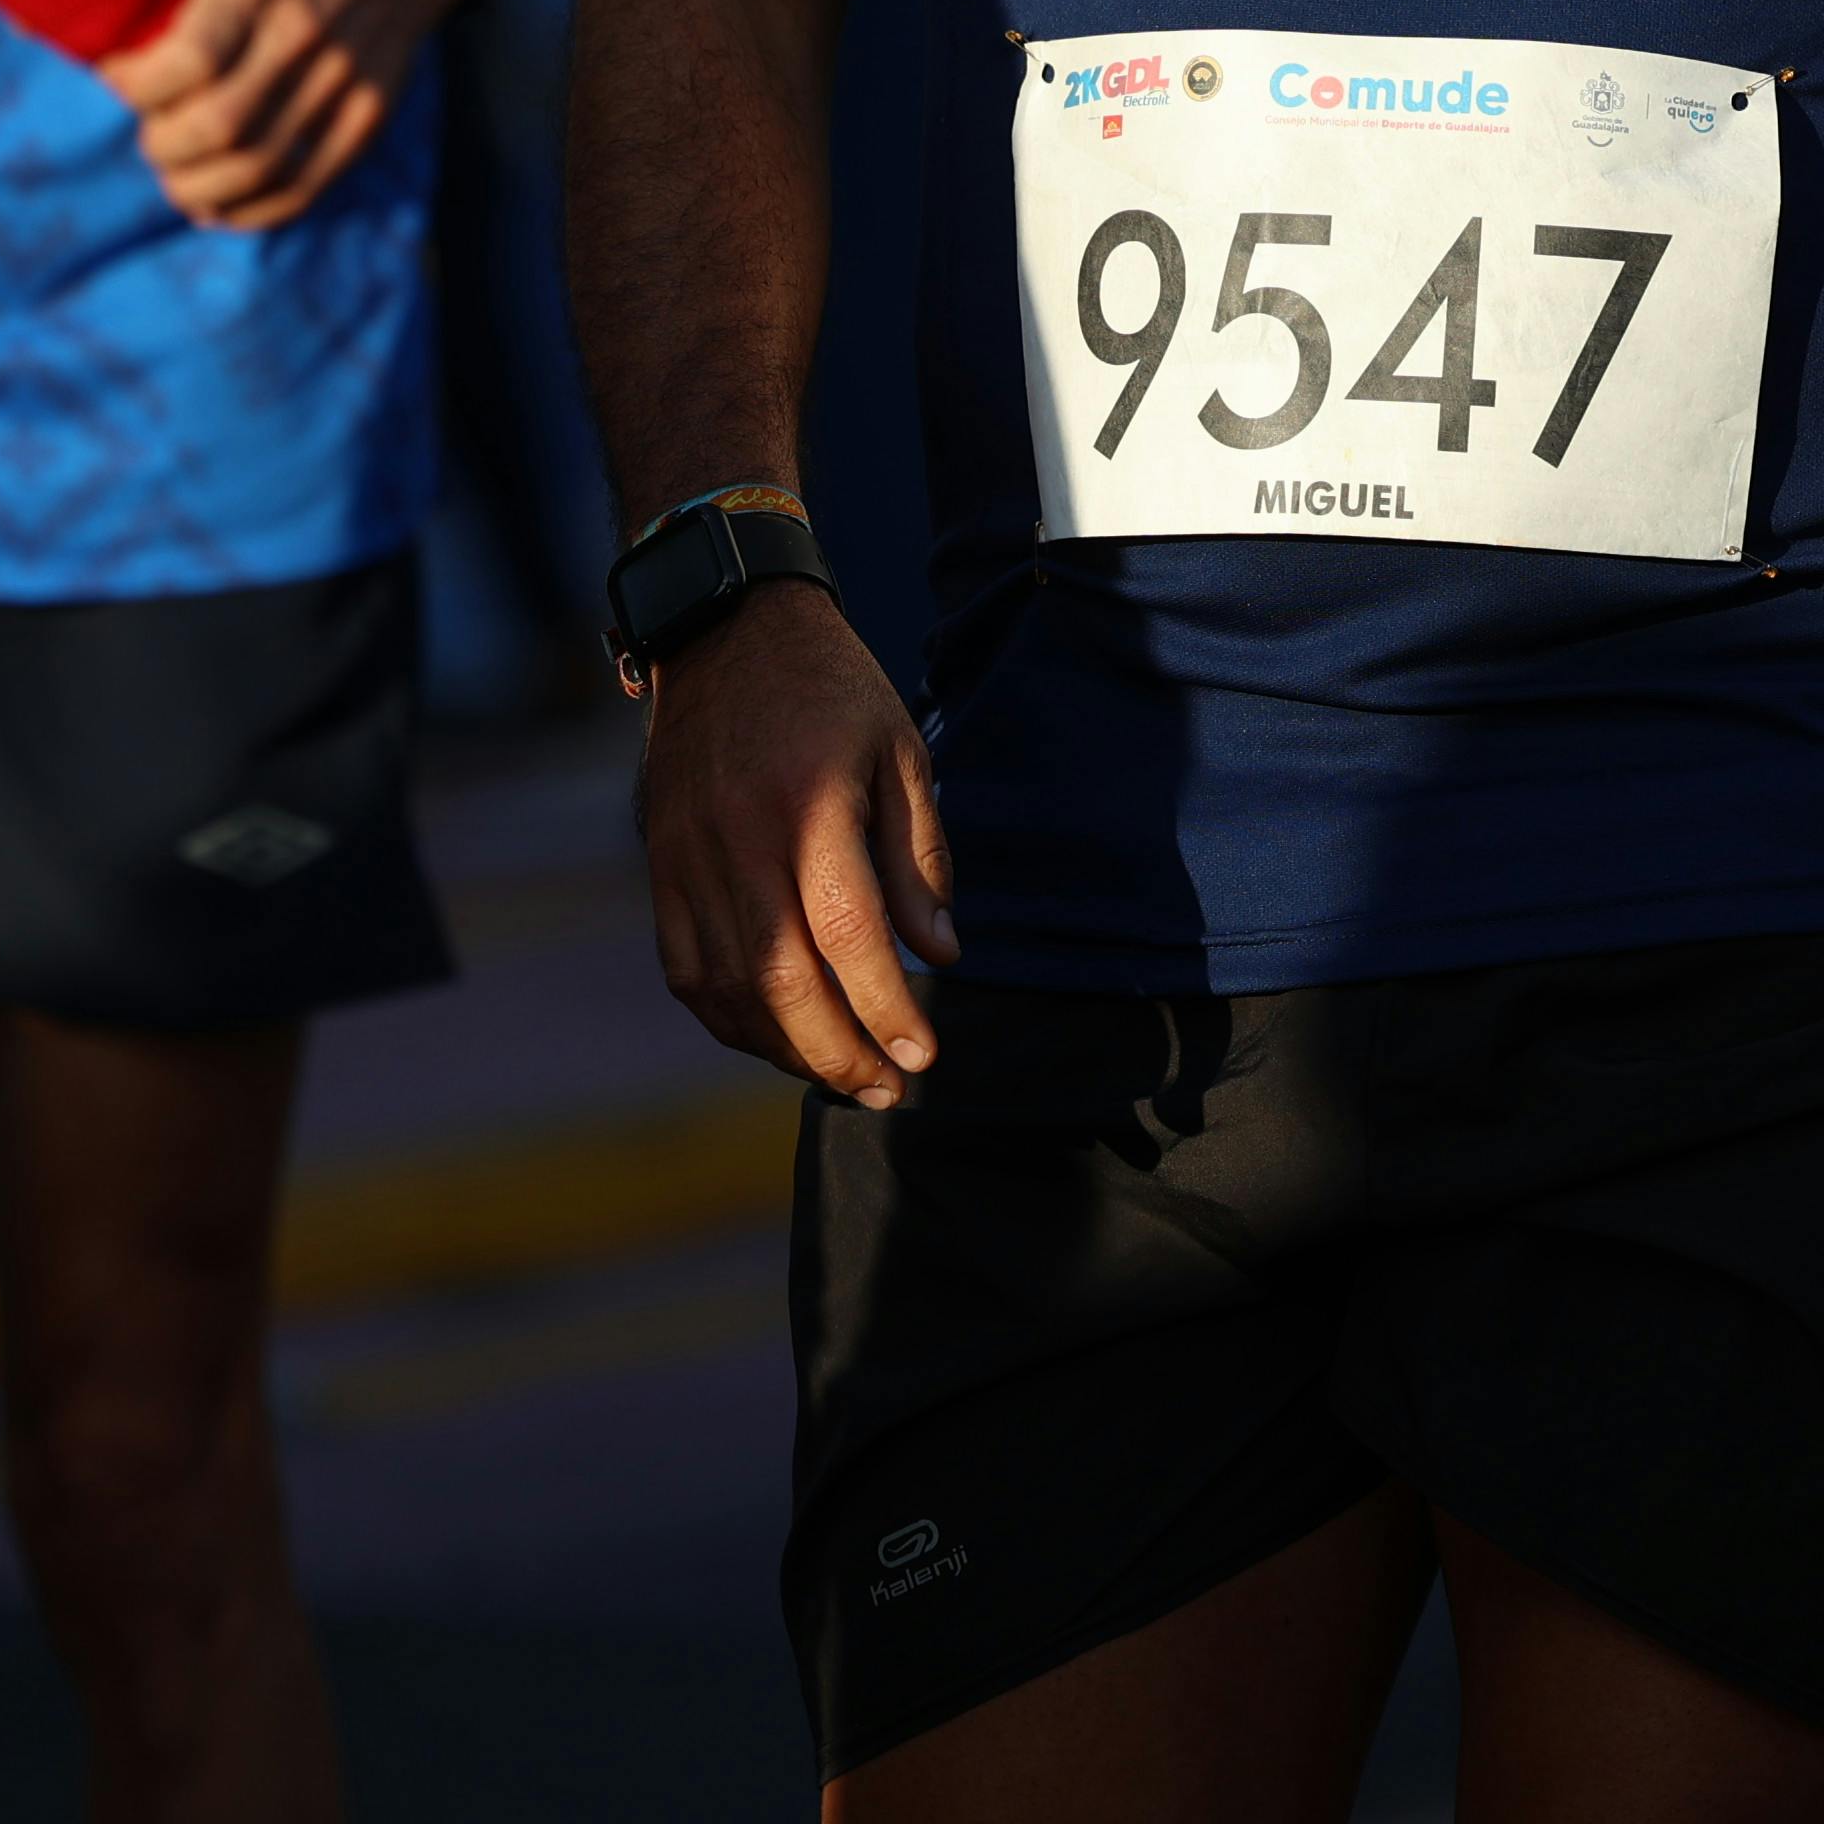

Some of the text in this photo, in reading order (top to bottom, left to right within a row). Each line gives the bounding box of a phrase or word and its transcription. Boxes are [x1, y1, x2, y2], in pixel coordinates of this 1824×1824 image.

[1269, 63, 1509, 116] Comude
[1123, 94, 1170, 107] Electrolit
[1673, 96, 1704, 109] Ciudad
[1265, 114, 1510, 134] Consejo Municipal del Deporte de Guadalajara
[1667, 106, 1714, 123] quiero
[1572, 120, 1629, 134] Guadalajara
[1078, 209, 1673, 467] 9547
[1253, 479, 1414, 520] MIGUEL
[870, 1545, 968, 1606] Kalenji
